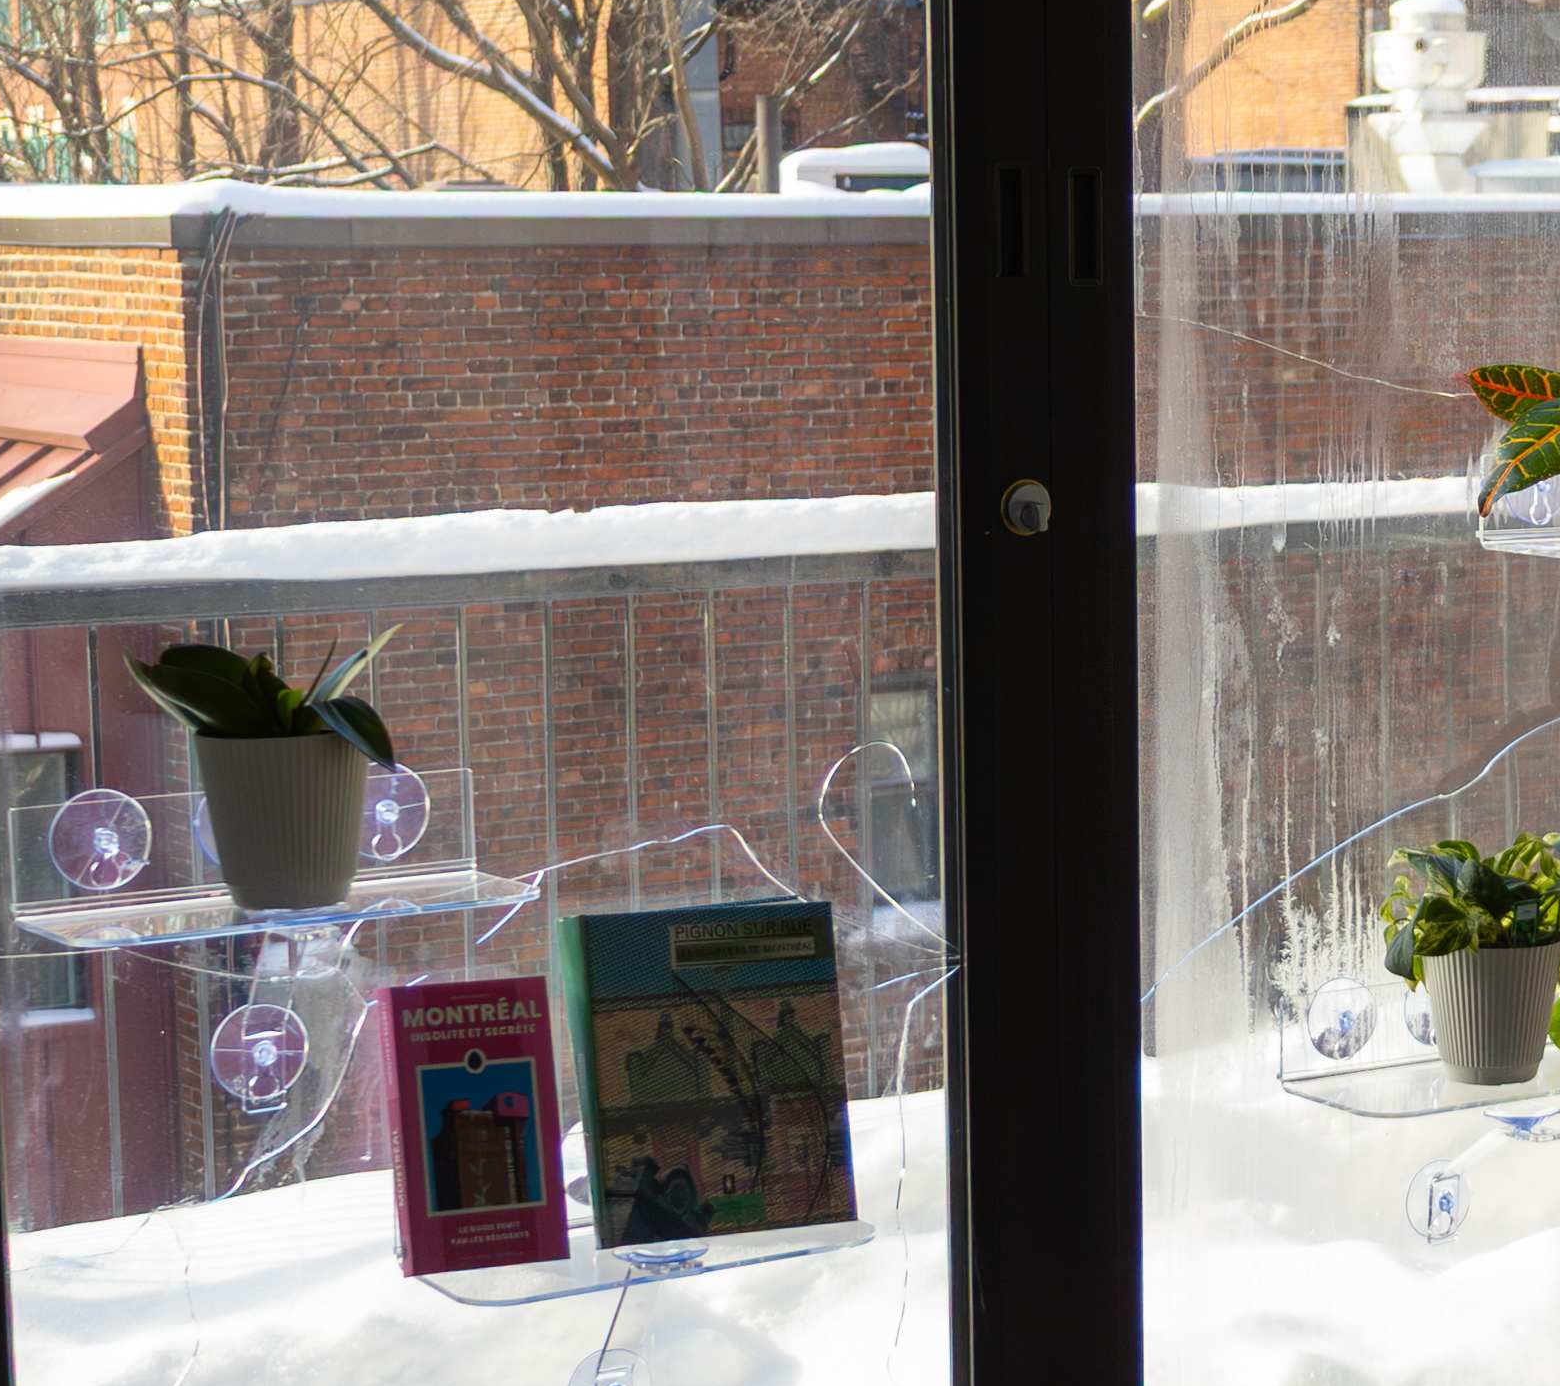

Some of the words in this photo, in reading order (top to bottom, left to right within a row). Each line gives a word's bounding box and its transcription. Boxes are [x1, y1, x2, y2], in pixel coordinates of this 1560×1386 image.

[675, 923, 738, 939] PIGNON
[743, 921, 776, 935] SUR
[402, 997, 542, 1028] MONTRÉAL
[410, 1028, 465, 1042] INSOLITE
[468, 1027, 481, 1038] ET
